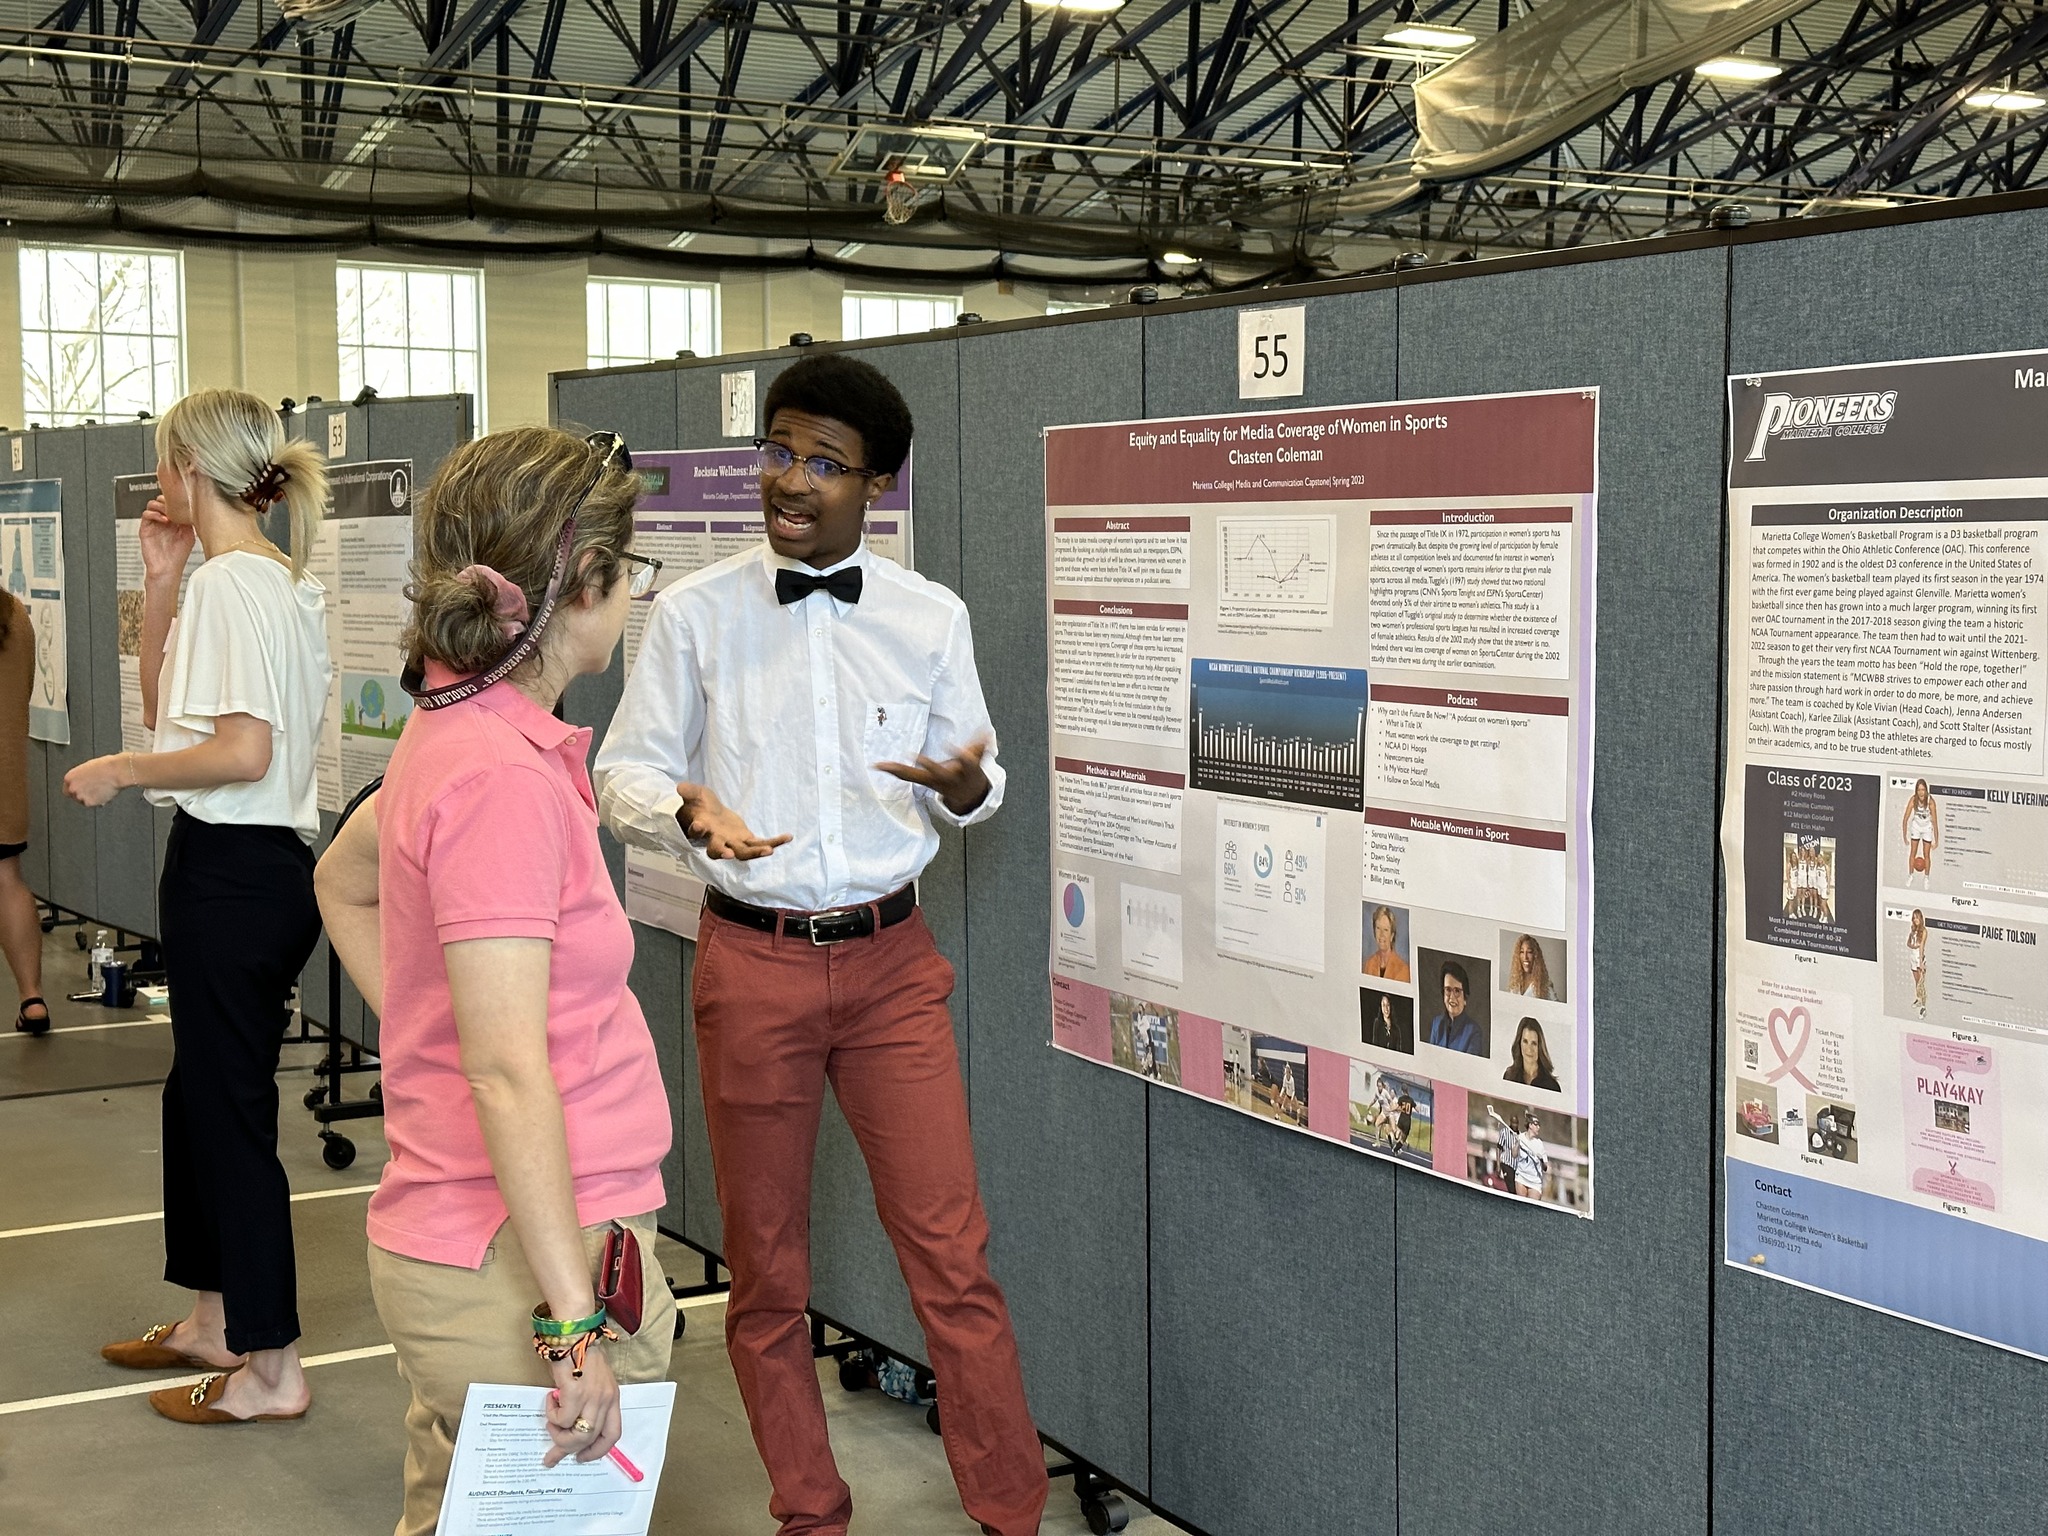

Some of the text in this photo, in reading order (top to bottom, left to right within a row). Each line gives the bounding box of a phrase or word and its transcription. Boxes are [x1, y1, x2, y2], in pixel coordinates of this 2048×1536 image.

[1253, 334, 1288, 379] 55
[730, 392, 748, 421] 54
[1129, 415, 1447, 449] Equity and Equality for Media Coverage of Women in Sports
[1744, 390, 1898, 462] PIONEERS
[1781, 423, 1887, 440] MARIETTA COLLEGE
[332, 424, 343, 447] 53
[1229, 447, 1322, 464] Chasten Coleman
[693, 464, 761, 476] Rockstar Wellness: Adv
[1192, 481, 1212, 489] Marietta
[1235, 479, 1250, 488] Media
[1252, 479, 1261, 487] and
[1263, 479, 1303, 487] Communication
[1332, 476, 1349, 487] Spring
[1351, 475, 1364, 484] 2023
[1442, 512, 1494, 522] Introduction
[1828, 506, 1962, 521] Organization Description
[1106, 520, 1130, 530] Abstract
[1377, 530, 1389, 538] Since
[1390, 530, 1398, 538] the
[1419, 530, 1426, 538] of
[1426, 529, 1439, 537] Title
[1439, 529, 1447, 537] IX
[1508, 529, 1530, 537] women's
[1532, 530, 1549, 538] sports
[1761, 532, 1791, 540] Marietta
[1792, 531, 1819, 542] College
[1821, 531, 1855, 540] Women's
[1857, 530, 1897, 539] Basketball
[1899, 530, 1933, 541] Program
[1935, 530, 1941, 539] is
[1950, 529, 1960, 538] D3
[1962, 528, 2001, 538] basketball
[2003, 530, 2038, 540] program
[1752, 544, 2029, 555] that competes within the Ohio Athletic Conference (OAC). This conference
[1766, 559, 1791, 568] formed
[1792, 559, 1799, 568] in
[1802, 559, 1819, 568] 1902
[1821, 559, 1835, 568] and
[1837, 559, 1843, 568] is
[1845, 559, 1858, 568] the
[1859, 559, 1883, 568] oldest
[1886, 559, 1896, 568] D3
[1898, 559, 1943, 568] conference
[1944, 559, 1952, 568] in
[1954, 559, 1967, 568] the
[1969, 559, 1995, 568] United
[1997, 559, 2021, 568] States
[2023, 558, 2032, 568] of
[1751, 573, 1780, 582] America.
[1782, 573, 1795, 582] The
[1797, 573, 1829, 582] women's
[1831, 573, 1870, 582] basketball
[1894, 574, 1920, 584] played
[1922, 574, 1931, 582] its
[1934, 573, 1949, 582] first
[1951, 575, 1978, 583] season
[1980, 574, 1987, 583] in
[1989, 574, 2003, 583] the
[2004, 576, 2022, 585] year
[2025, 574, 2043, 583] 1974
[1100, 604, 1133, 615] Conclusions
[431, 600, 556, 706] CAROLINA GAMECOCKS CAROLINA
[1447, 693, 1477, 705] Podcast
[1086, 765, 1146, 780] Methods and Materials
[1767, 771, 1851, 791] Class of 2023
[1987, 789, 2009, 803] KELLY
[1371, 830, 1408, 842] Serena Williams
[1410, 817, 1509, 841] Notable Women in Sport
[1370, 841, 1405, 852] Danica Patrick
[1258, 856, 1268, 868] 84%
[1370, 852, 1400, 865] Dawn Staley
[1224, 862, 1236, 876] 66%
[1370, 874, 1404, 889] Billie Jean King
[1951, 896, 1971, 905] Figure
[1981, 926, 2036, 945] PAIGE TOLSON
[1794, 954, 1811, 962] Figure
[1053, 978, 1070, 991] Contact
[1952, 1031, 1979, 1044] Figure 3.
[1917, 1077, 1984, 1106] PLAY4KAY
[1800, 1154, 1817, 1163] Figure
[1754, 1180, 1792, 1198] Contact
[1755, 1201, 1808, 1220] Chasten Coleman
[1942, 1202, 1967, 1216] Figure 5.
[1756, 1212, 1867, 1249] Marietta College Women's Basketball
